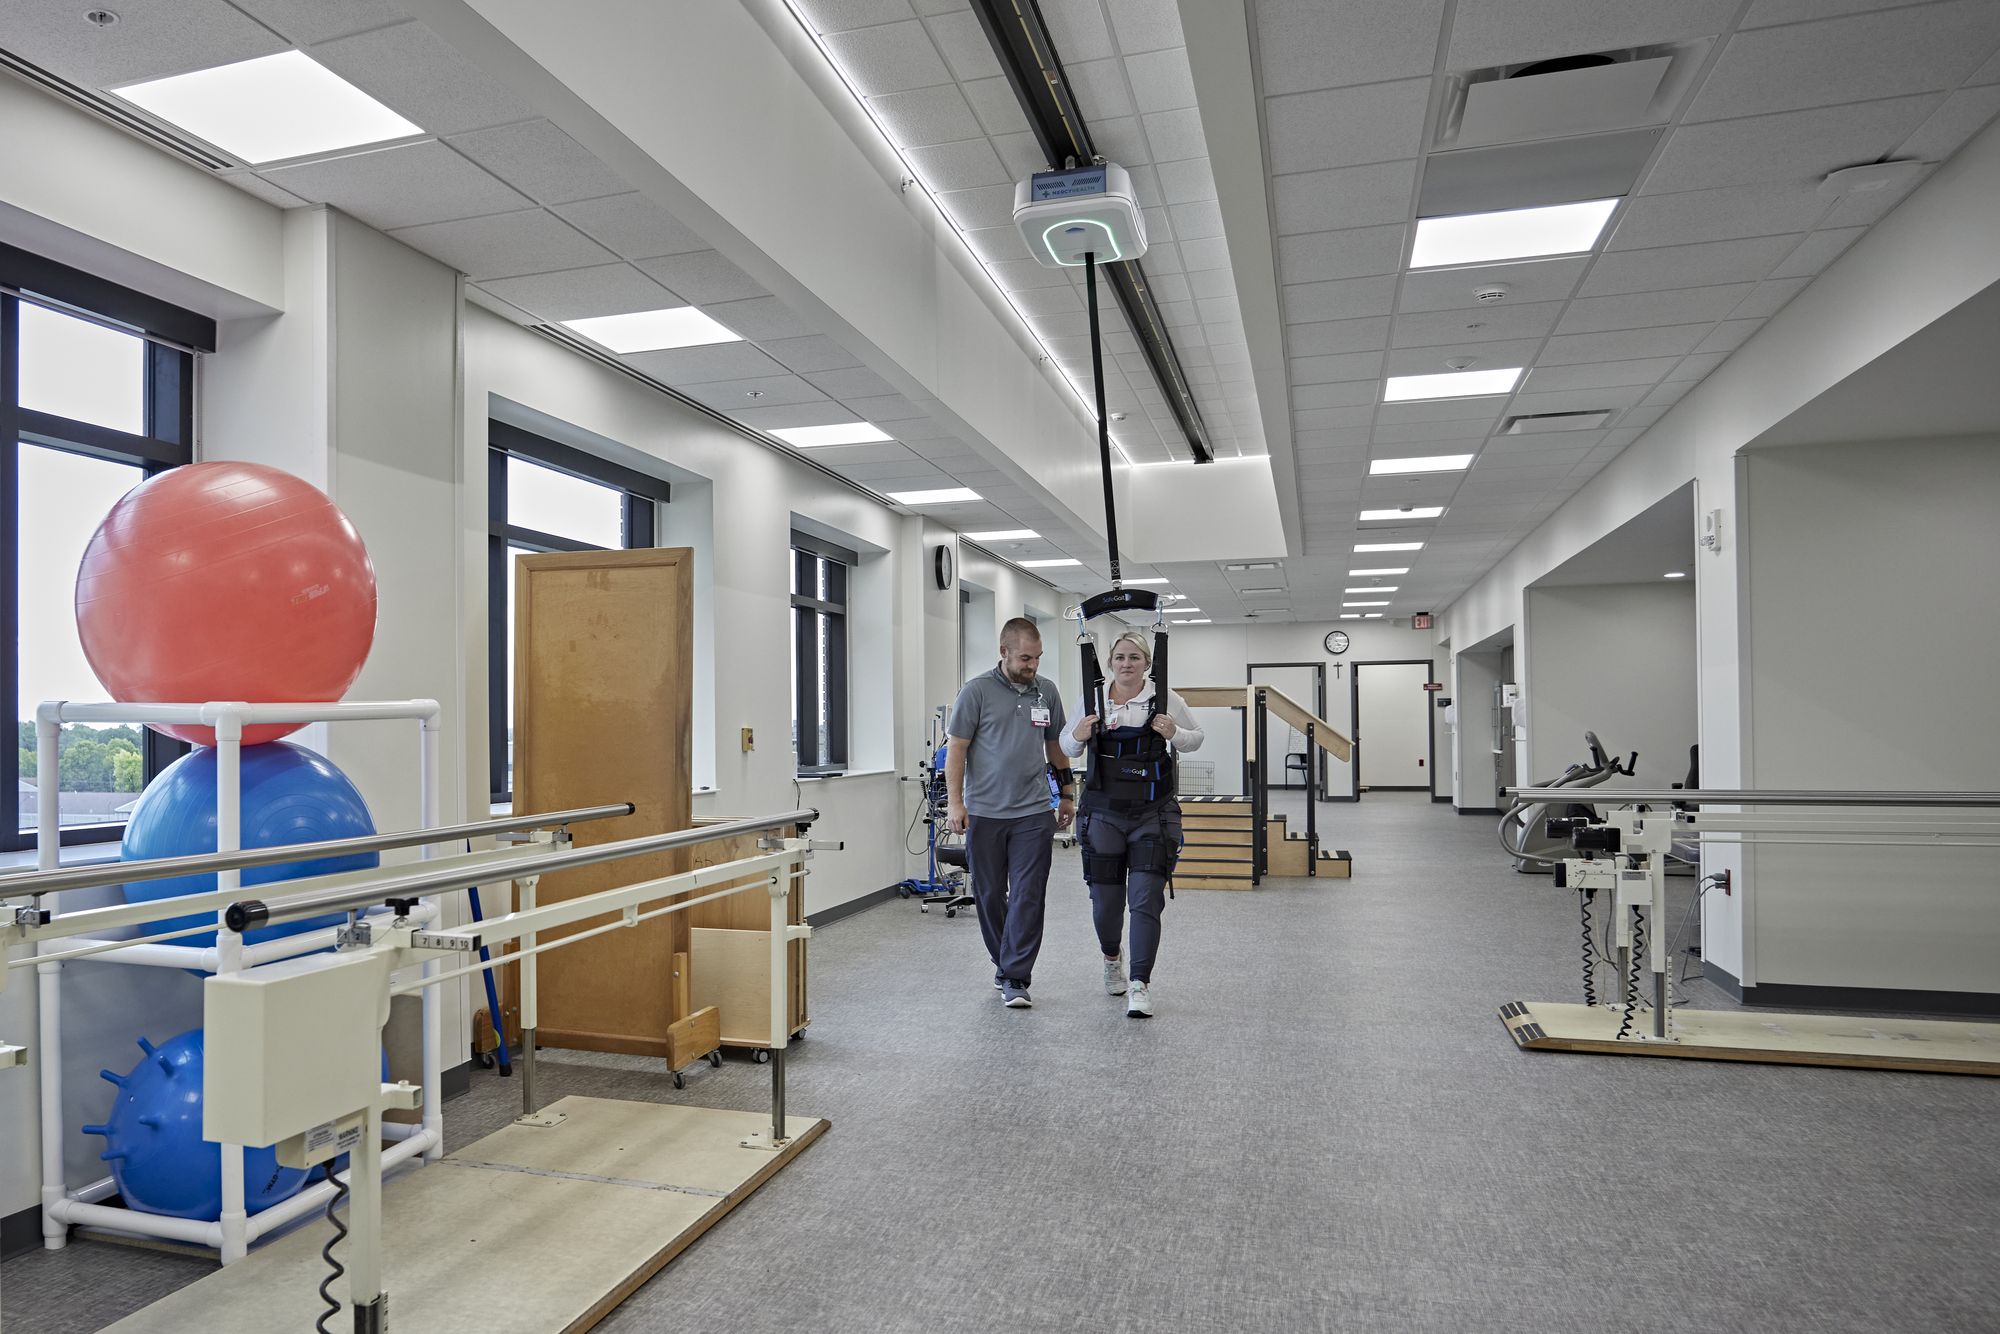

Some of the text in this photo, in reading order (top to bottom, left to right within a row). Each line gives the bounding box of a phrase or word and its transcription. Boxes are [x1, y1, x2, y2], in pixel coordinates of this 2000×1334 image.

[1415, 616, 1431, 629] EXIT
[423, 937, 469, 948] 7 8 9 10
